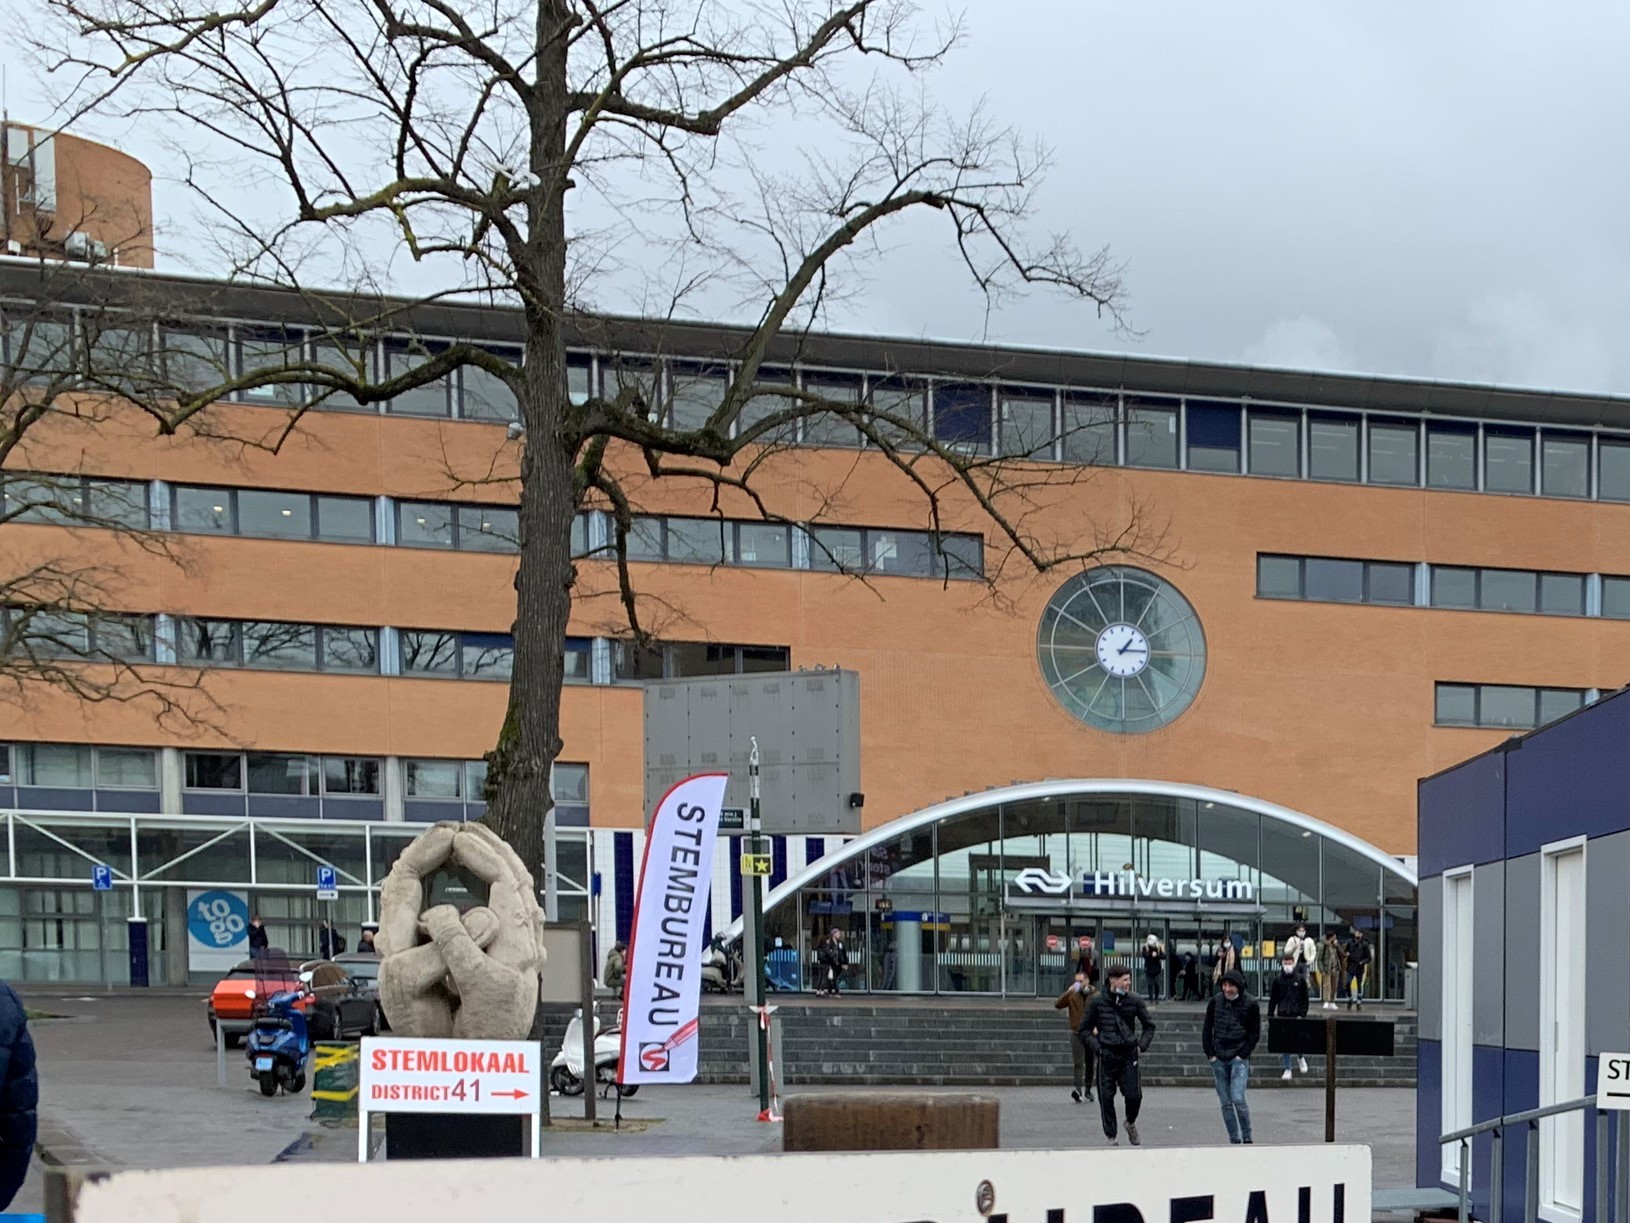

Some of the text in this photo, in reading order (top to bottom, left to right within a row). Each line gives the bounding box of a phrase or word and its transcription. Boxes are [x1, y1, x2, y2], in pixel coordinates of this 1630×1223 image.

[1095, 869, 1253, 899] Hilversum
[198, 898, 231, 922] to
[647, 801, 706, 1026] STEMBUREAU
[209, 914, 245, 945] go
[371, 1048, 530, 1074] STEMLOKAAL
[371, 1078, 481, 1102] DISTRICT 41
